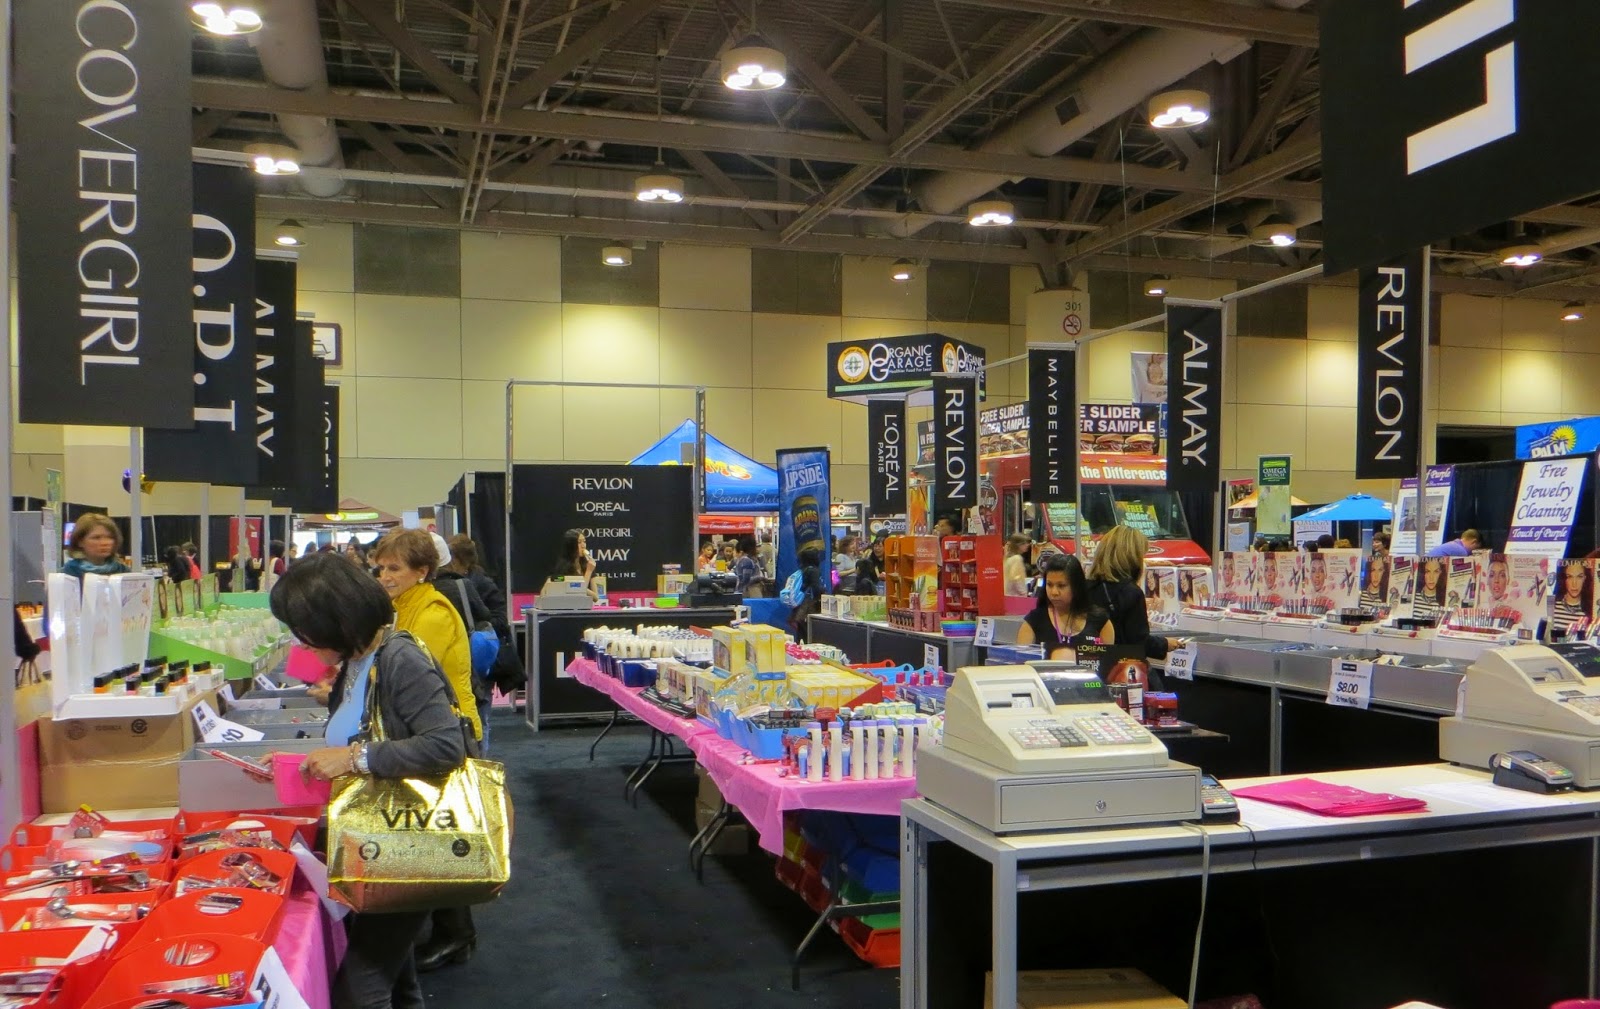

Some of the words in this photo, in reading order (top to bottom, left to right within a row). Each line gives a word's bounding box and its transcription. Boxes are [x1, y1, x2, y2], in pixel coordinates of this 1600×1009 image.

[76, 0, 140, 386] COVERGIRL
[1065, 302, 1081, 311] 301
[869, 343, 932, 367] ORGANIC
[1374, 266, 1406, 461] REVLON
[870, 358, 932, 381] GARAGE
[1182, 330, 1209, 467] ALMAY
[1000, 404, 1024, 420] SLIDER
[1090, 406, 1140, 419] SLIDER
[980, 422, 1001, 436] URGER
[1002, 416, 1030, 433] SAMPLE
[1047, 358, 1059, 495] MAYBELLINE
[1098, 420, 1156, 432] SAMPLE
[944, 389, 966, 499] REVLON
[786, 466, 823, 491] UPSIDE
[1080, 466, 1100, 479] the
[1104, 466, 1166, 480] Difference
[1539, 464, 1568, 478] Free
[573, 478, 633, 490] REVLON
[1522, 481, 1574, 501] Jewelry
[709, 488, 751, 504] Peanut
[1517, 503, 1572, 523] Cleaning
[582, 528, 633, 537] OVERGIRL
[1512, 527, 1534, 538] Touch
[1543, 526, 1568, 539] Purple
[590, 549, 631, 561] LMAY
[1337, 681, 1358, 694] $8.00
[381, 804, 458, 829] viva
